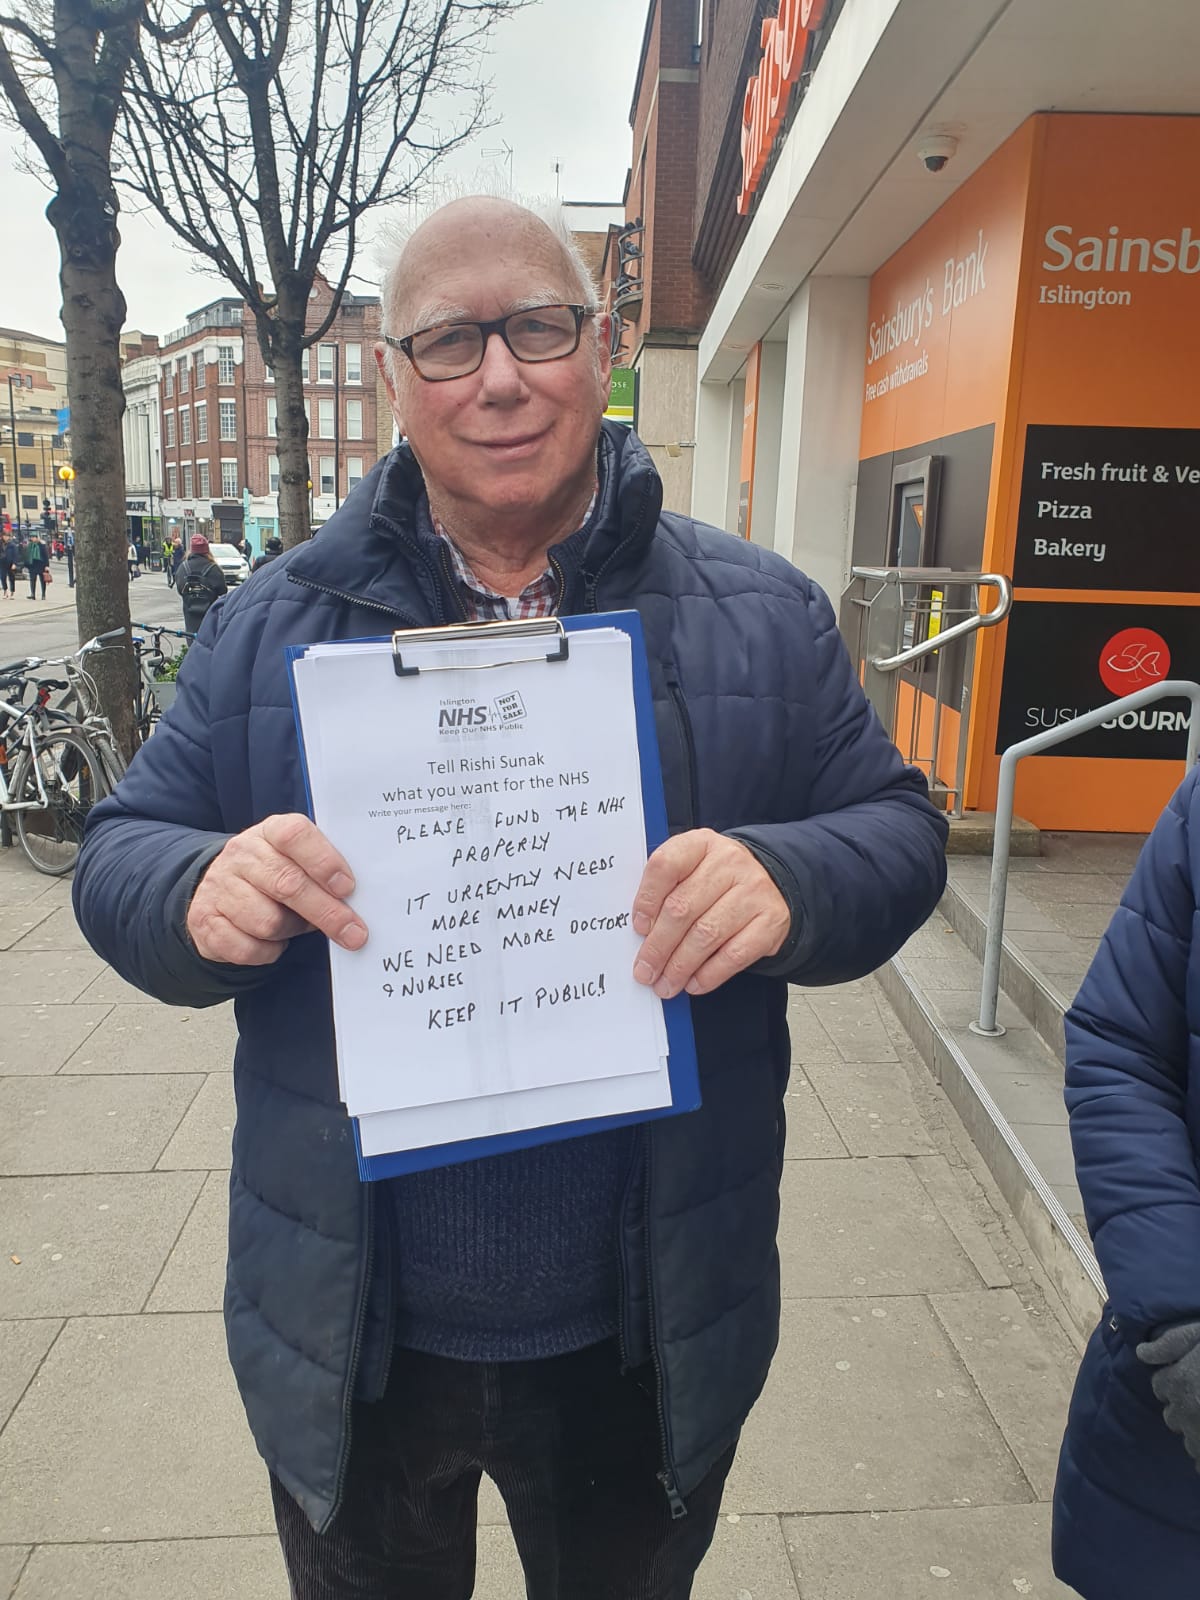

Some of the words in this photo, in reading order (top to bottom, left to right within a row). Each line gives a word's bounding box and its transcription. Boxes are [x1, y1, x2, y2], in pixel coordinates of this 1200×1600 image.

[1042, 225, 1200, 274] Sainsb
[867, 278, 934, 365] Sainsbury's
[942, 229, 989, 316] Bank
[1039, 285, 1132, 310] Islington
[865, 383, 877, 402] Free
[877, 371, 889, 398] cash
[889, 349, 929, 391] withdrawals
[1041, 462, 1096, 480] Fresh
[1101, 462, 1148, 482] fruit
[1152, 465, 1169, 483] &
[1175, 466, 1200, 484] Ve
[1037, 500, 1092, 519] Pizza
[1034, 538, 1106, 562] Bakery
[439, 698, 475, 706] Islington
[498, 694, 516, 706] NOT
[502, 702, 518, 712] FOR
[438, 706, 487, 727] NHS
[503, 709, 524, 721] SALE
[439, 728, 460, 736] Keep
[499, 722, 524, 731] Public
[427, 759, 455, 775] Tell
[460, 756, 495, 772] Rishi
[500, 752, 545, 769] Sunak
[382, 787, 423, 803] what
[427, 785, 456, 802] you
[461, 780, 499, 795] want
[503, 777, 525, 792] for
[529, 774, 554, 789] the
[559, 771, 590, 787] NHS
[368, 809, 391, 818] Write
[393, 808, 412, 817] your
[414, 805, 448, 814] message
[450, 803, 472, 811] here:
[397, 817, 465, 844] PLEASE
[495, 808, 540, 829] FUND
[555, 801, 588, 822] THE
[597, 796, 626, 815] NHS
[451, 831, 551, 868] PROPERLY
[406, 893, 430, 915] IT
[447, 868, 542, 904] URGENTLY
[553, 855, 615, 881] NEEDS
[431, 909, 480, 931] MORE
[496, 895, 561, 920] MONEY
[382, 949, 414, 973] WE
[427, 941, 482, 967] NEED
[502, 928, 556, 950] MORE
[569, 912, 630, 935] DOCTORS
[401, 971, 464, 997] NURSES
[428, 1002, 476, 1030] KEEP
[499, 997, 523, 1015] IT
